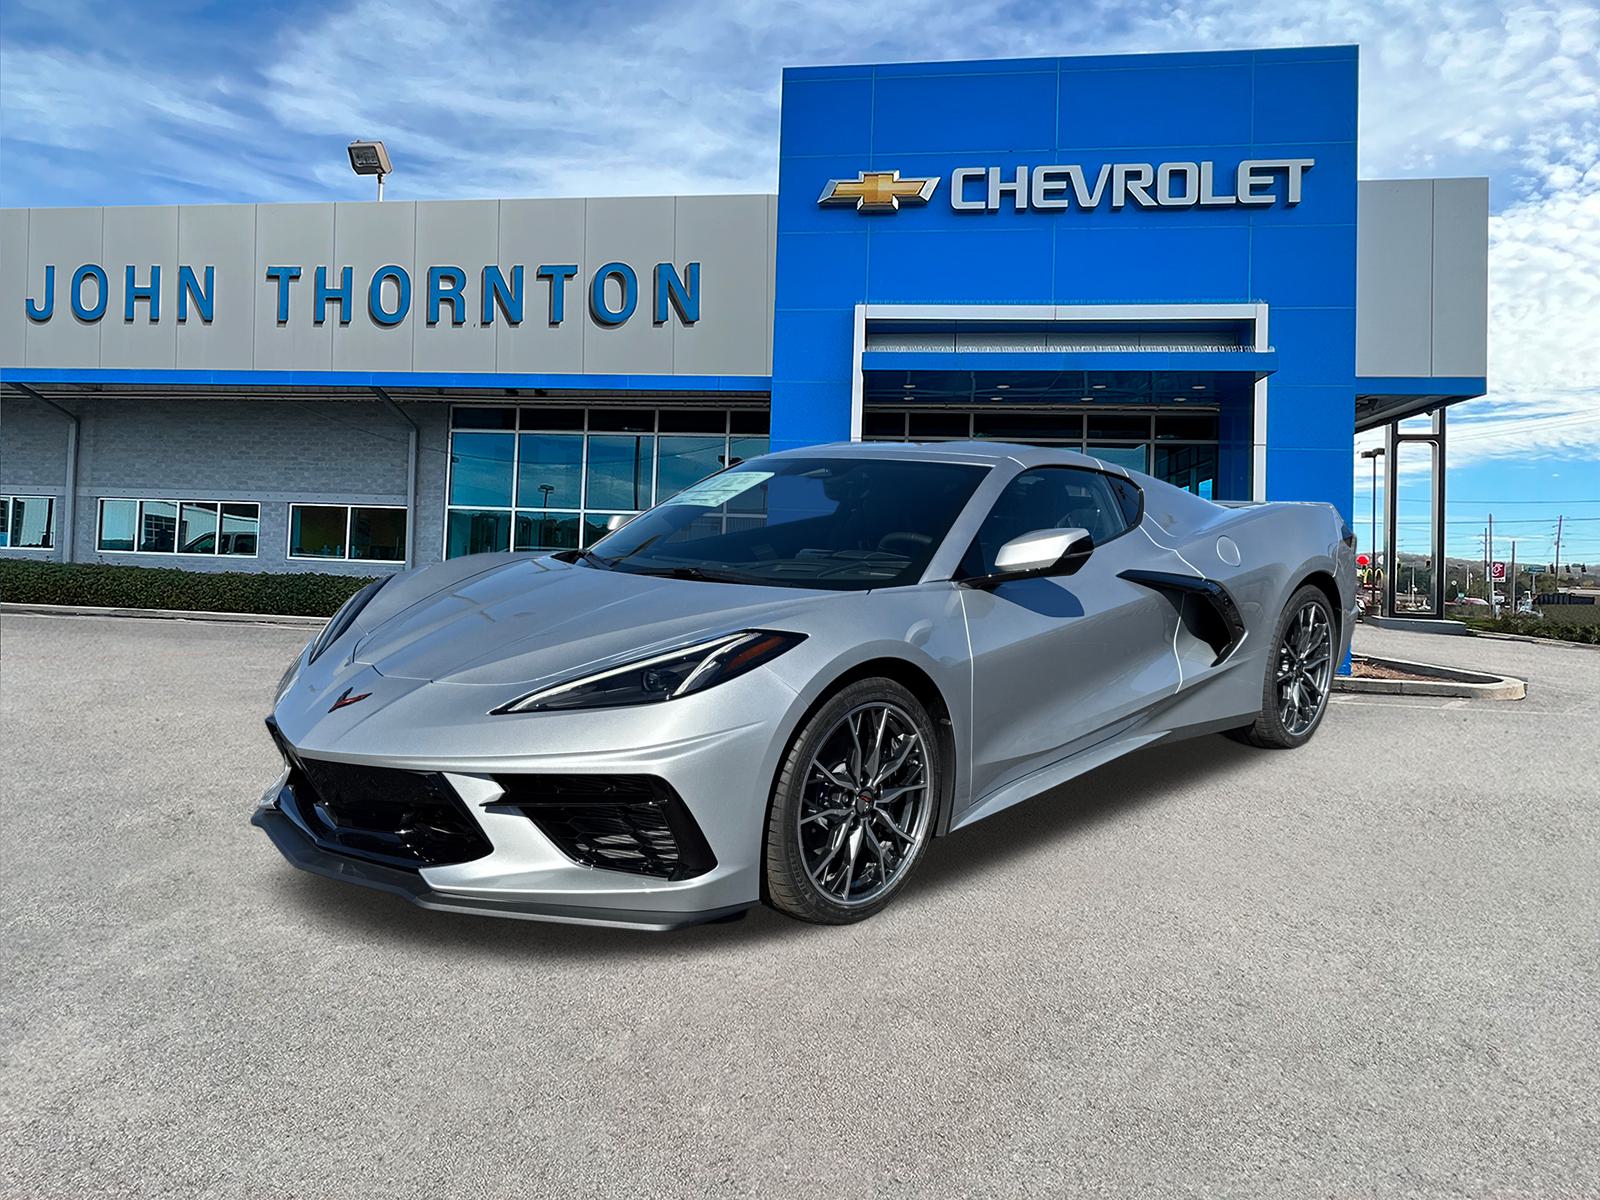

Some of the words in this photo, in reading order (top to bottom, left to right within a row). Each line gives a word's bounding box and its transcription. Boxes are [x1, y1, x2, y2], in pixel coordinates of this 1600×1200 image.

[950, 158, 1316, 211] CHEVROLET
[25, 263, 216, 324] JOHN
[266, 262, 702, 327] THORNTON
